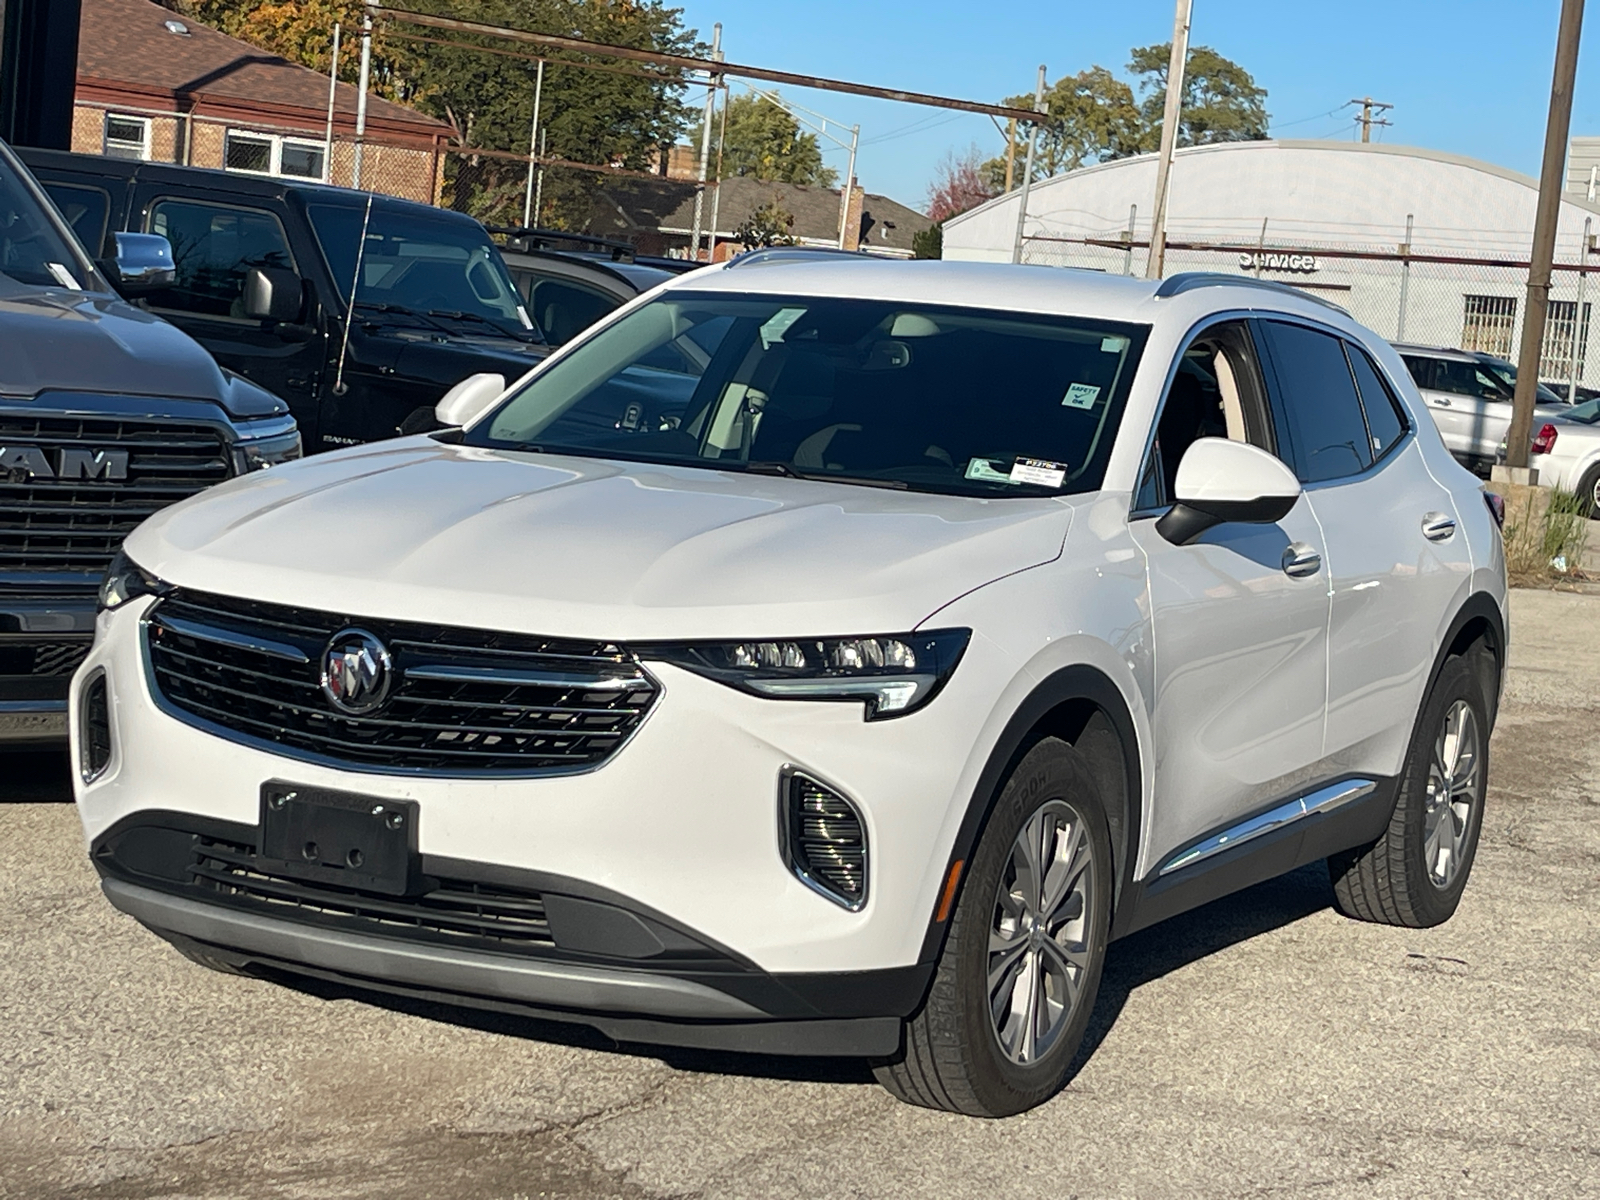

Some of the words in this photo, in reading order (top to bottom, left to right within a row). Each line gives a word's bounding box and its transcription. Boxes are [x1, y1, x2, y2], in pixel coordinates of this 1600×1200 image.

[1240, 252, 1317, 270] Service
[1071, 385, 1097, 394] SAFETY
[0, 446, 128, 479] AM
